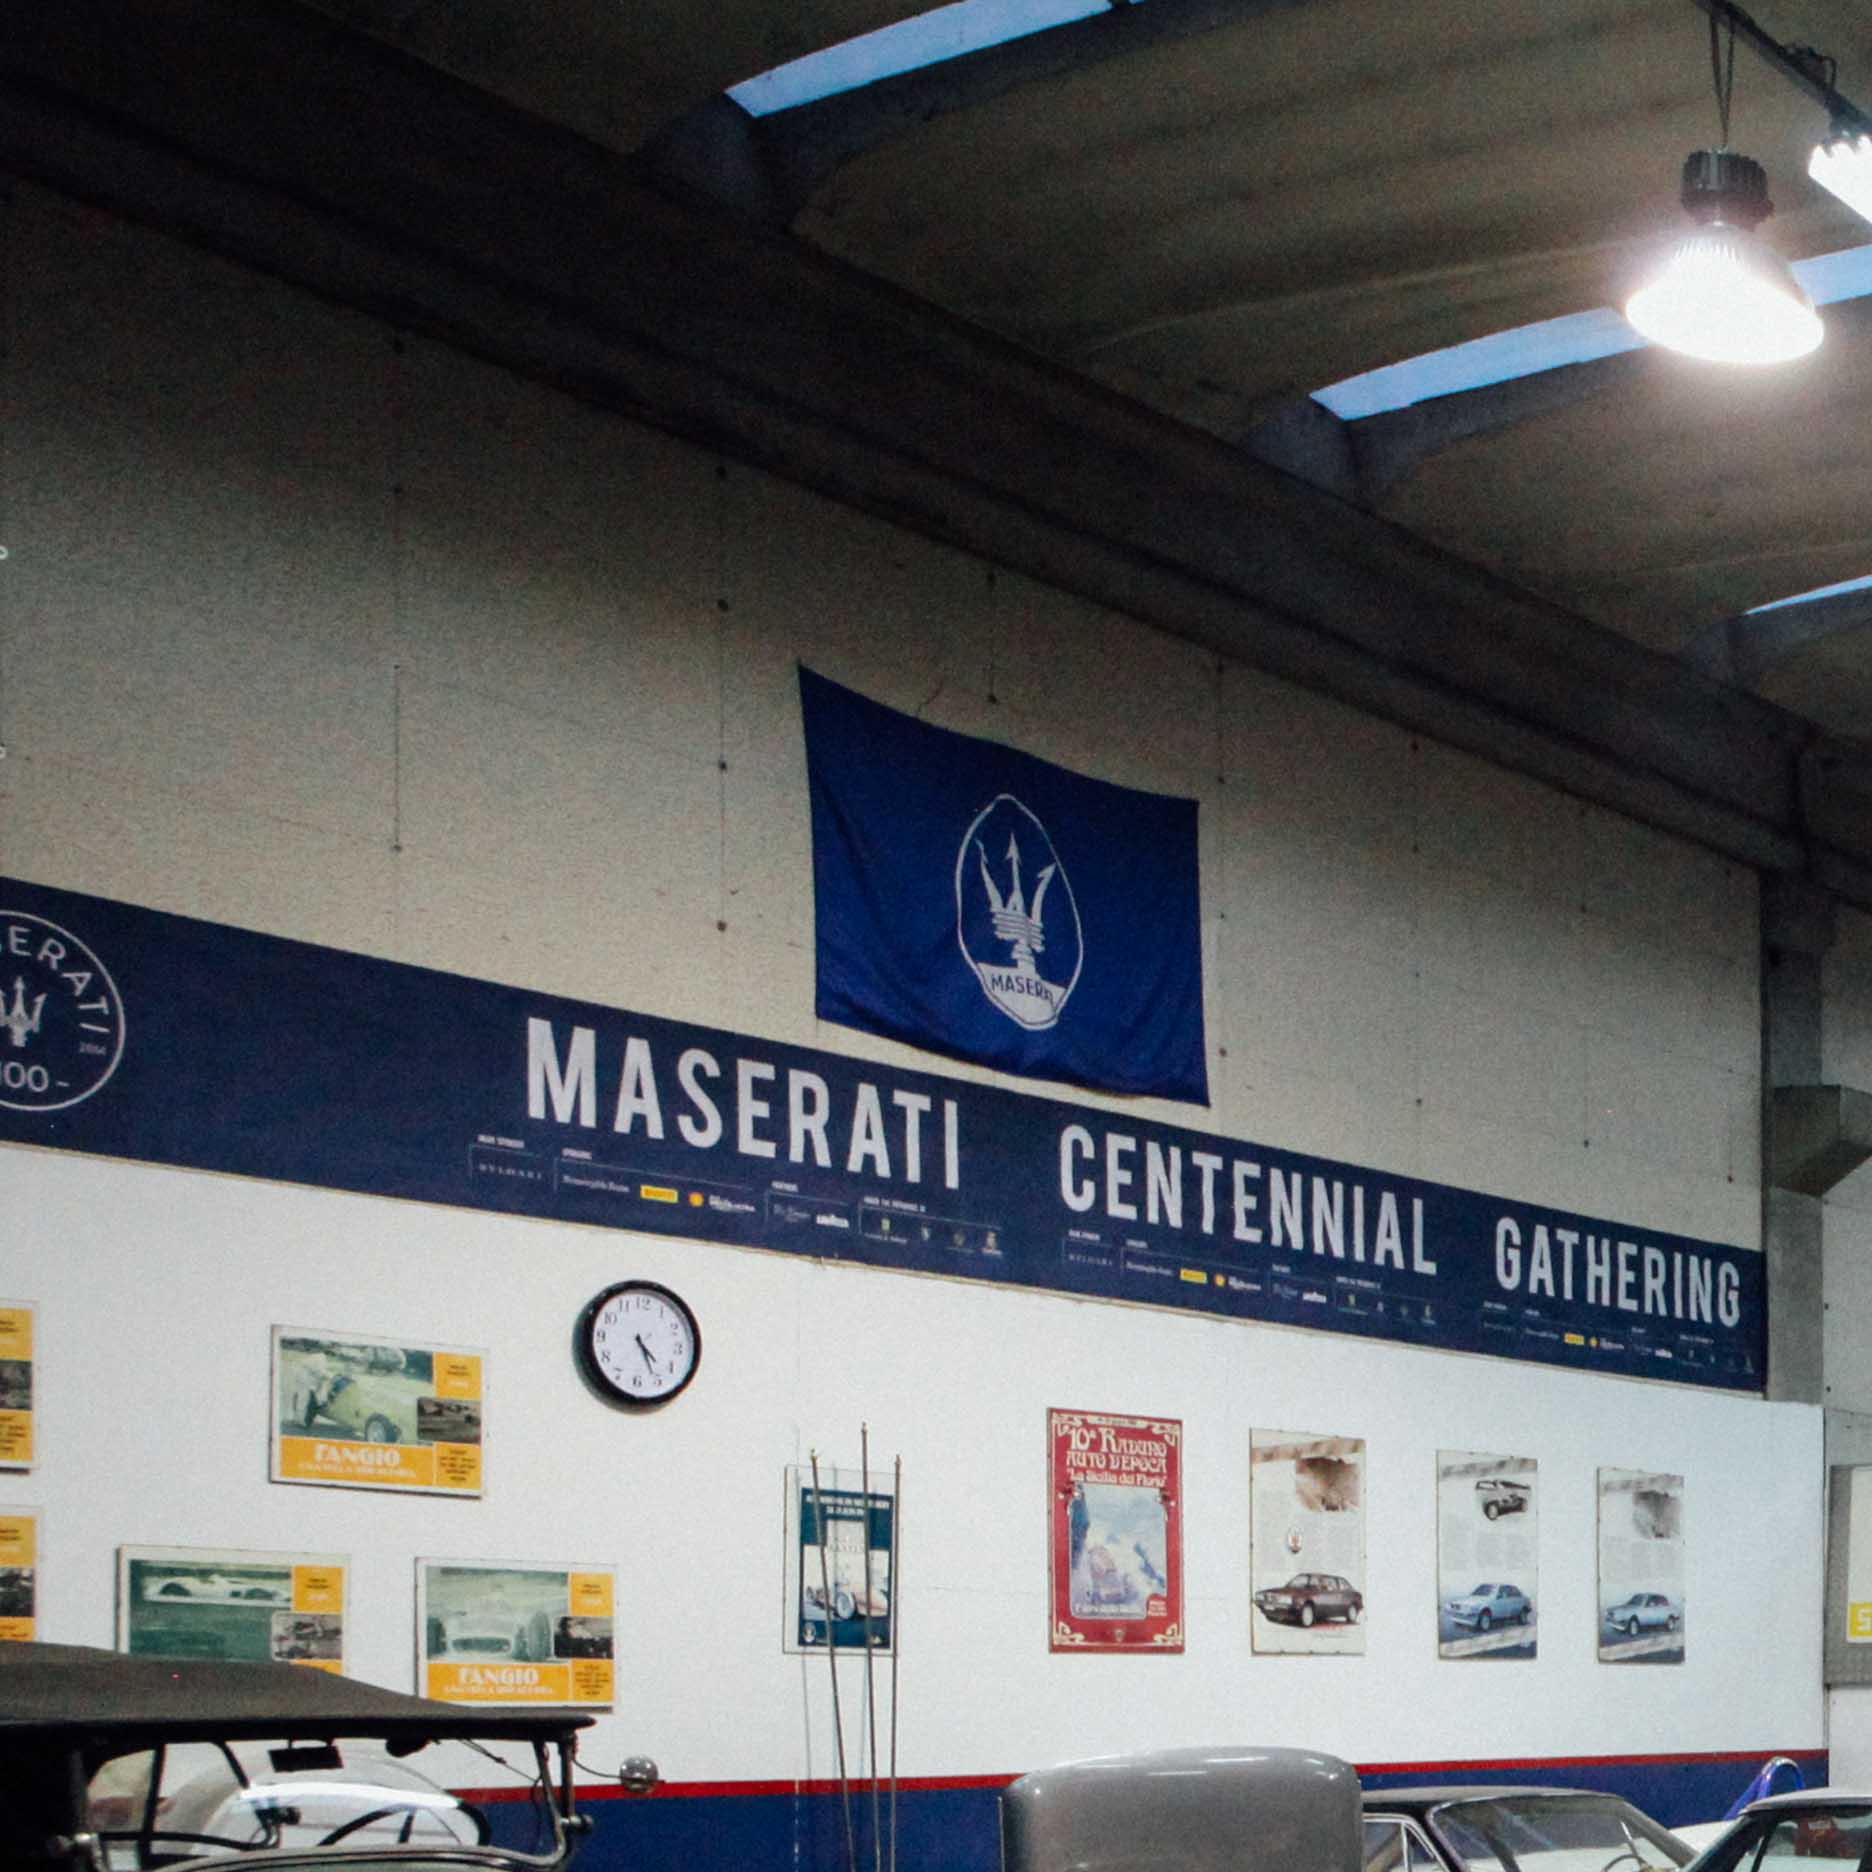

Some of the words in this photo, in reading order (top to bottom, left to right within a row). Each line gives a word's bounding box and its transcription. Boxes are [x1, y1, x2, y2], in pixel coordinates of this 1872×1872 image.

[0, 925, 111, 1033] ERATI
[0, 1061, 49, 1093] 00
[527, 1017, 960, 1190] MASERATI
[1060, 1124, 1438, 1276] CENTENNIAL
[1495, 1217, 1742, 1329] GATHERING
